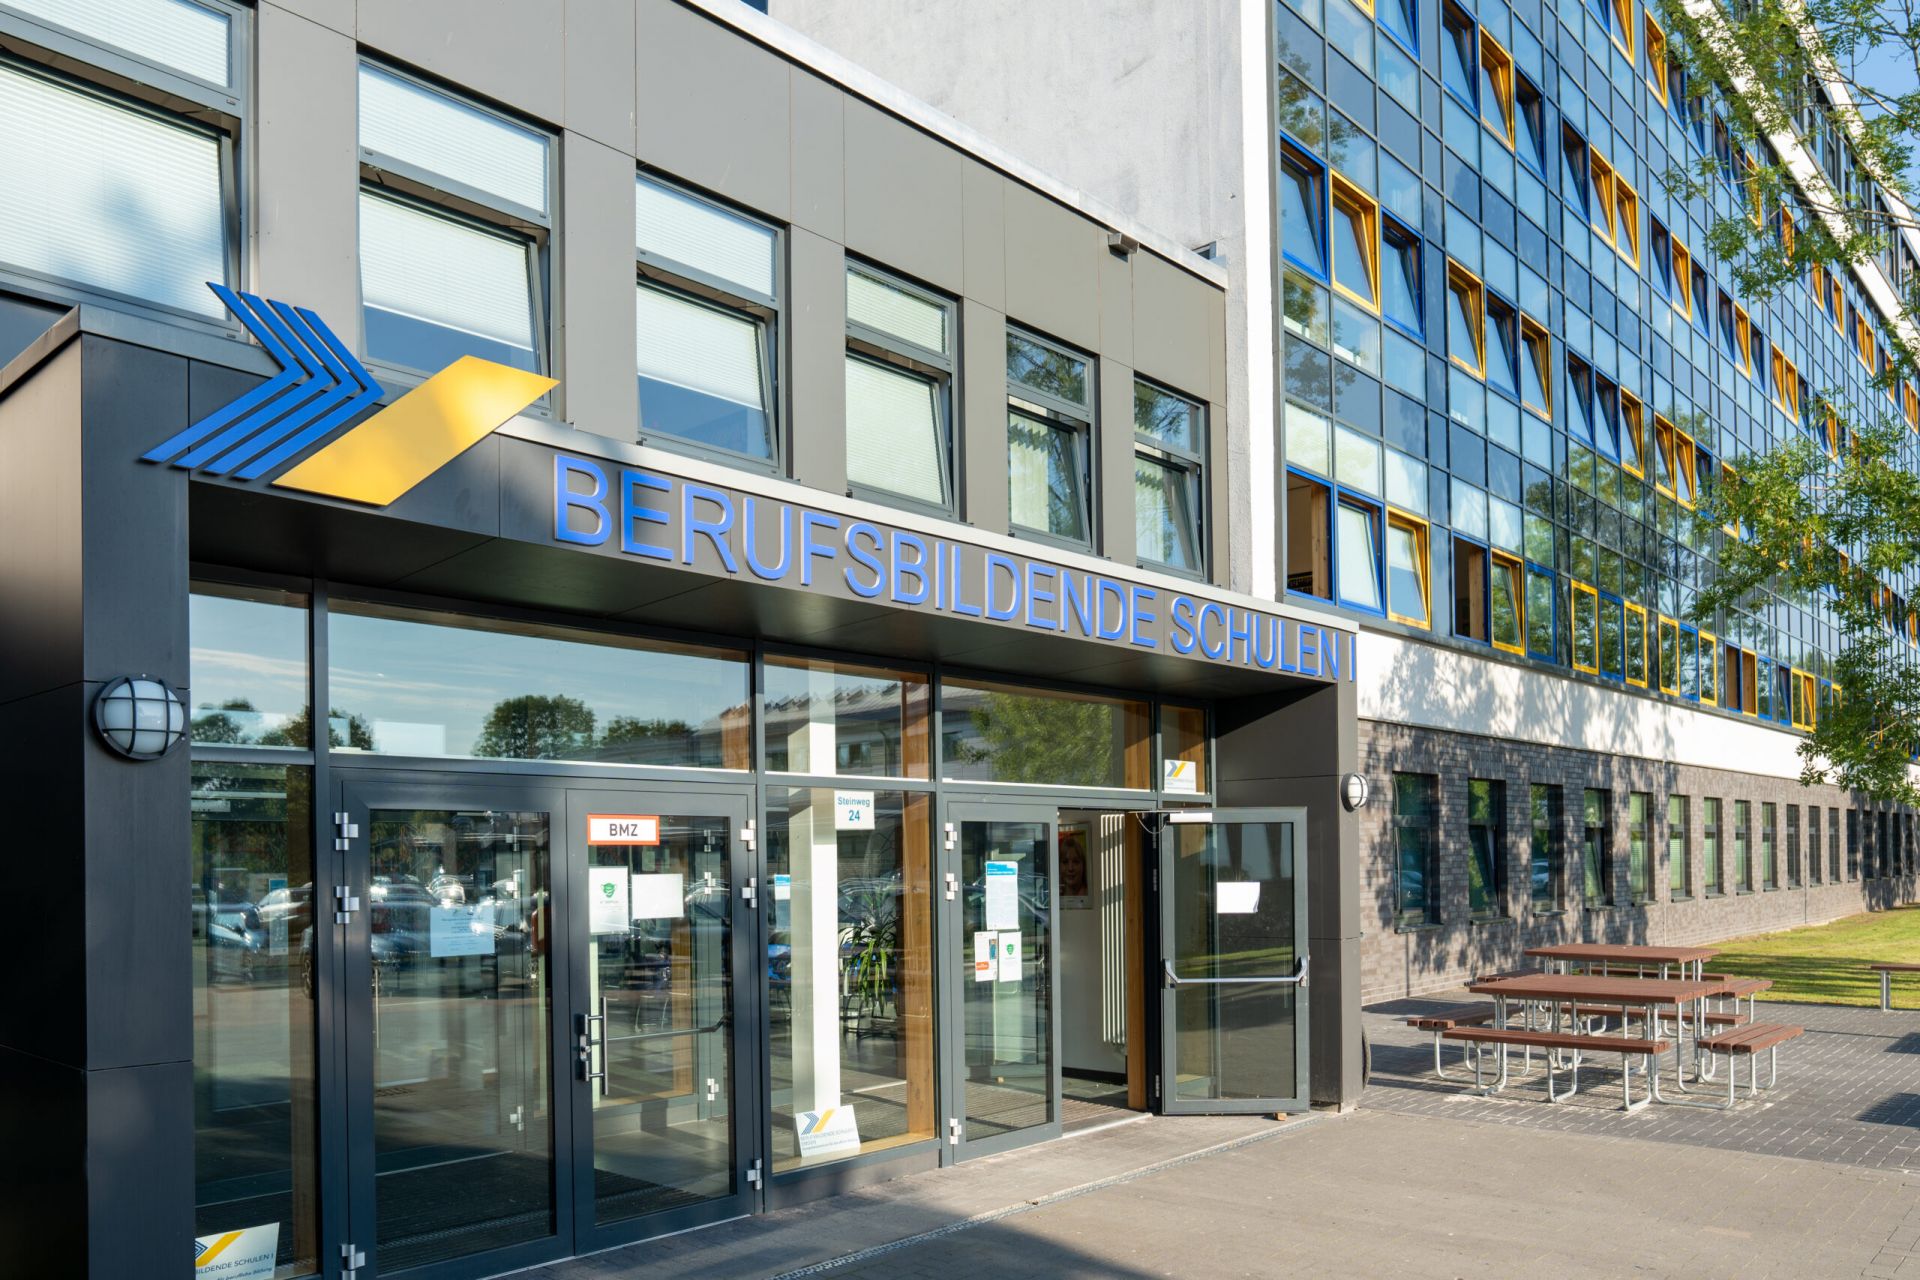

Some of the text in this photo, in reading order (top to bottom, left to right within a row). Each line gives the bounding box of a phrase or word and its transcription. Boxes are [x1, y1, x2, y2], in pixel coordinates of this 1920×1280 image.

[553, 454, 1356, 682] BERUFSBILDENDE SCHULEN I
[837, 796, 870, 807] Steinweg
[848, 810, 860, 821] 24
[609, 823, 638, 837] BMZ
[234, 1254, 270, 1267] SCHULEN
